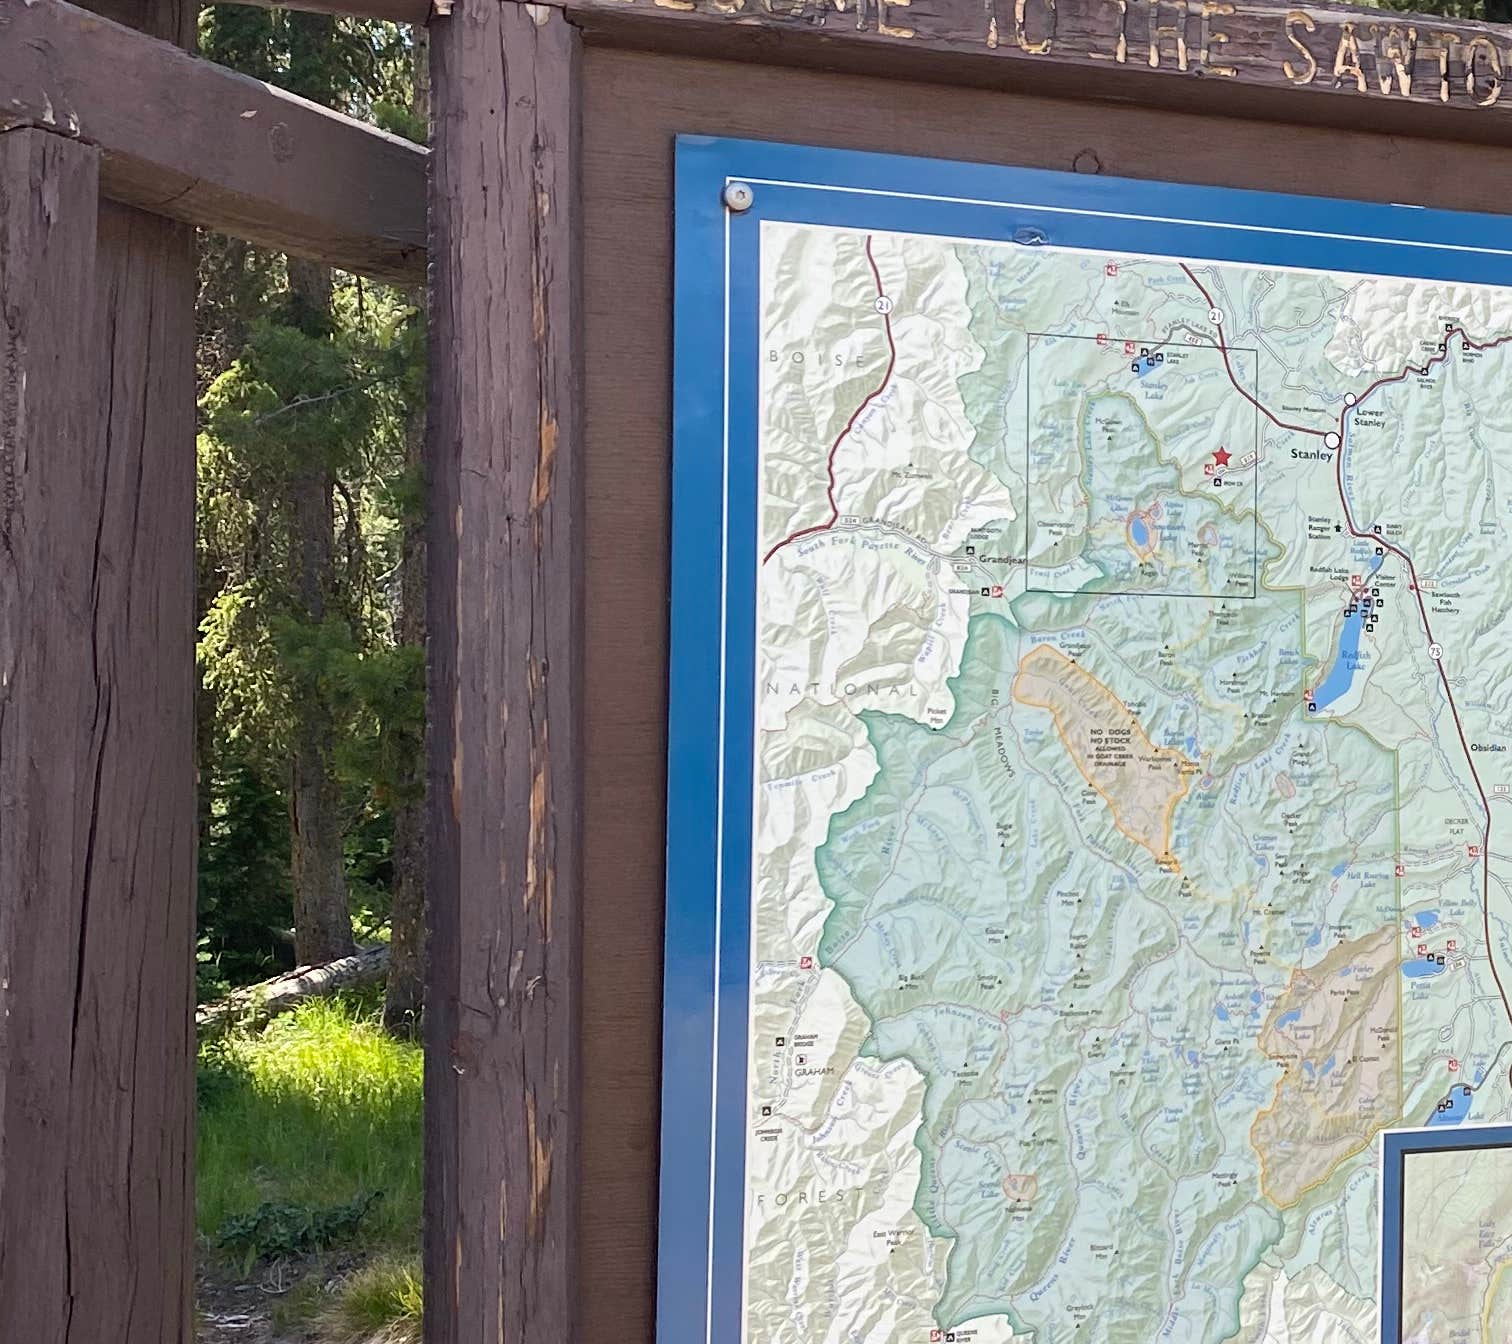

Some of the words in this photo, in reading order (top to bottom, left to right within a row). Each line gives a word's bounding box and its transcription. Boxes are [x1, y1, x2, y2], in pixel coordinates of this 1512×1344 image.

[878, 300, 890, 311] 21
[1211, 311, 1222, 322] 21
[1356, 408, 1384, 417] Lower
[1354, 418, 1385, 428] Stanley
[1291, 449, 1332, 462] Stanley
[1430, 647, 1441, 656] 75
